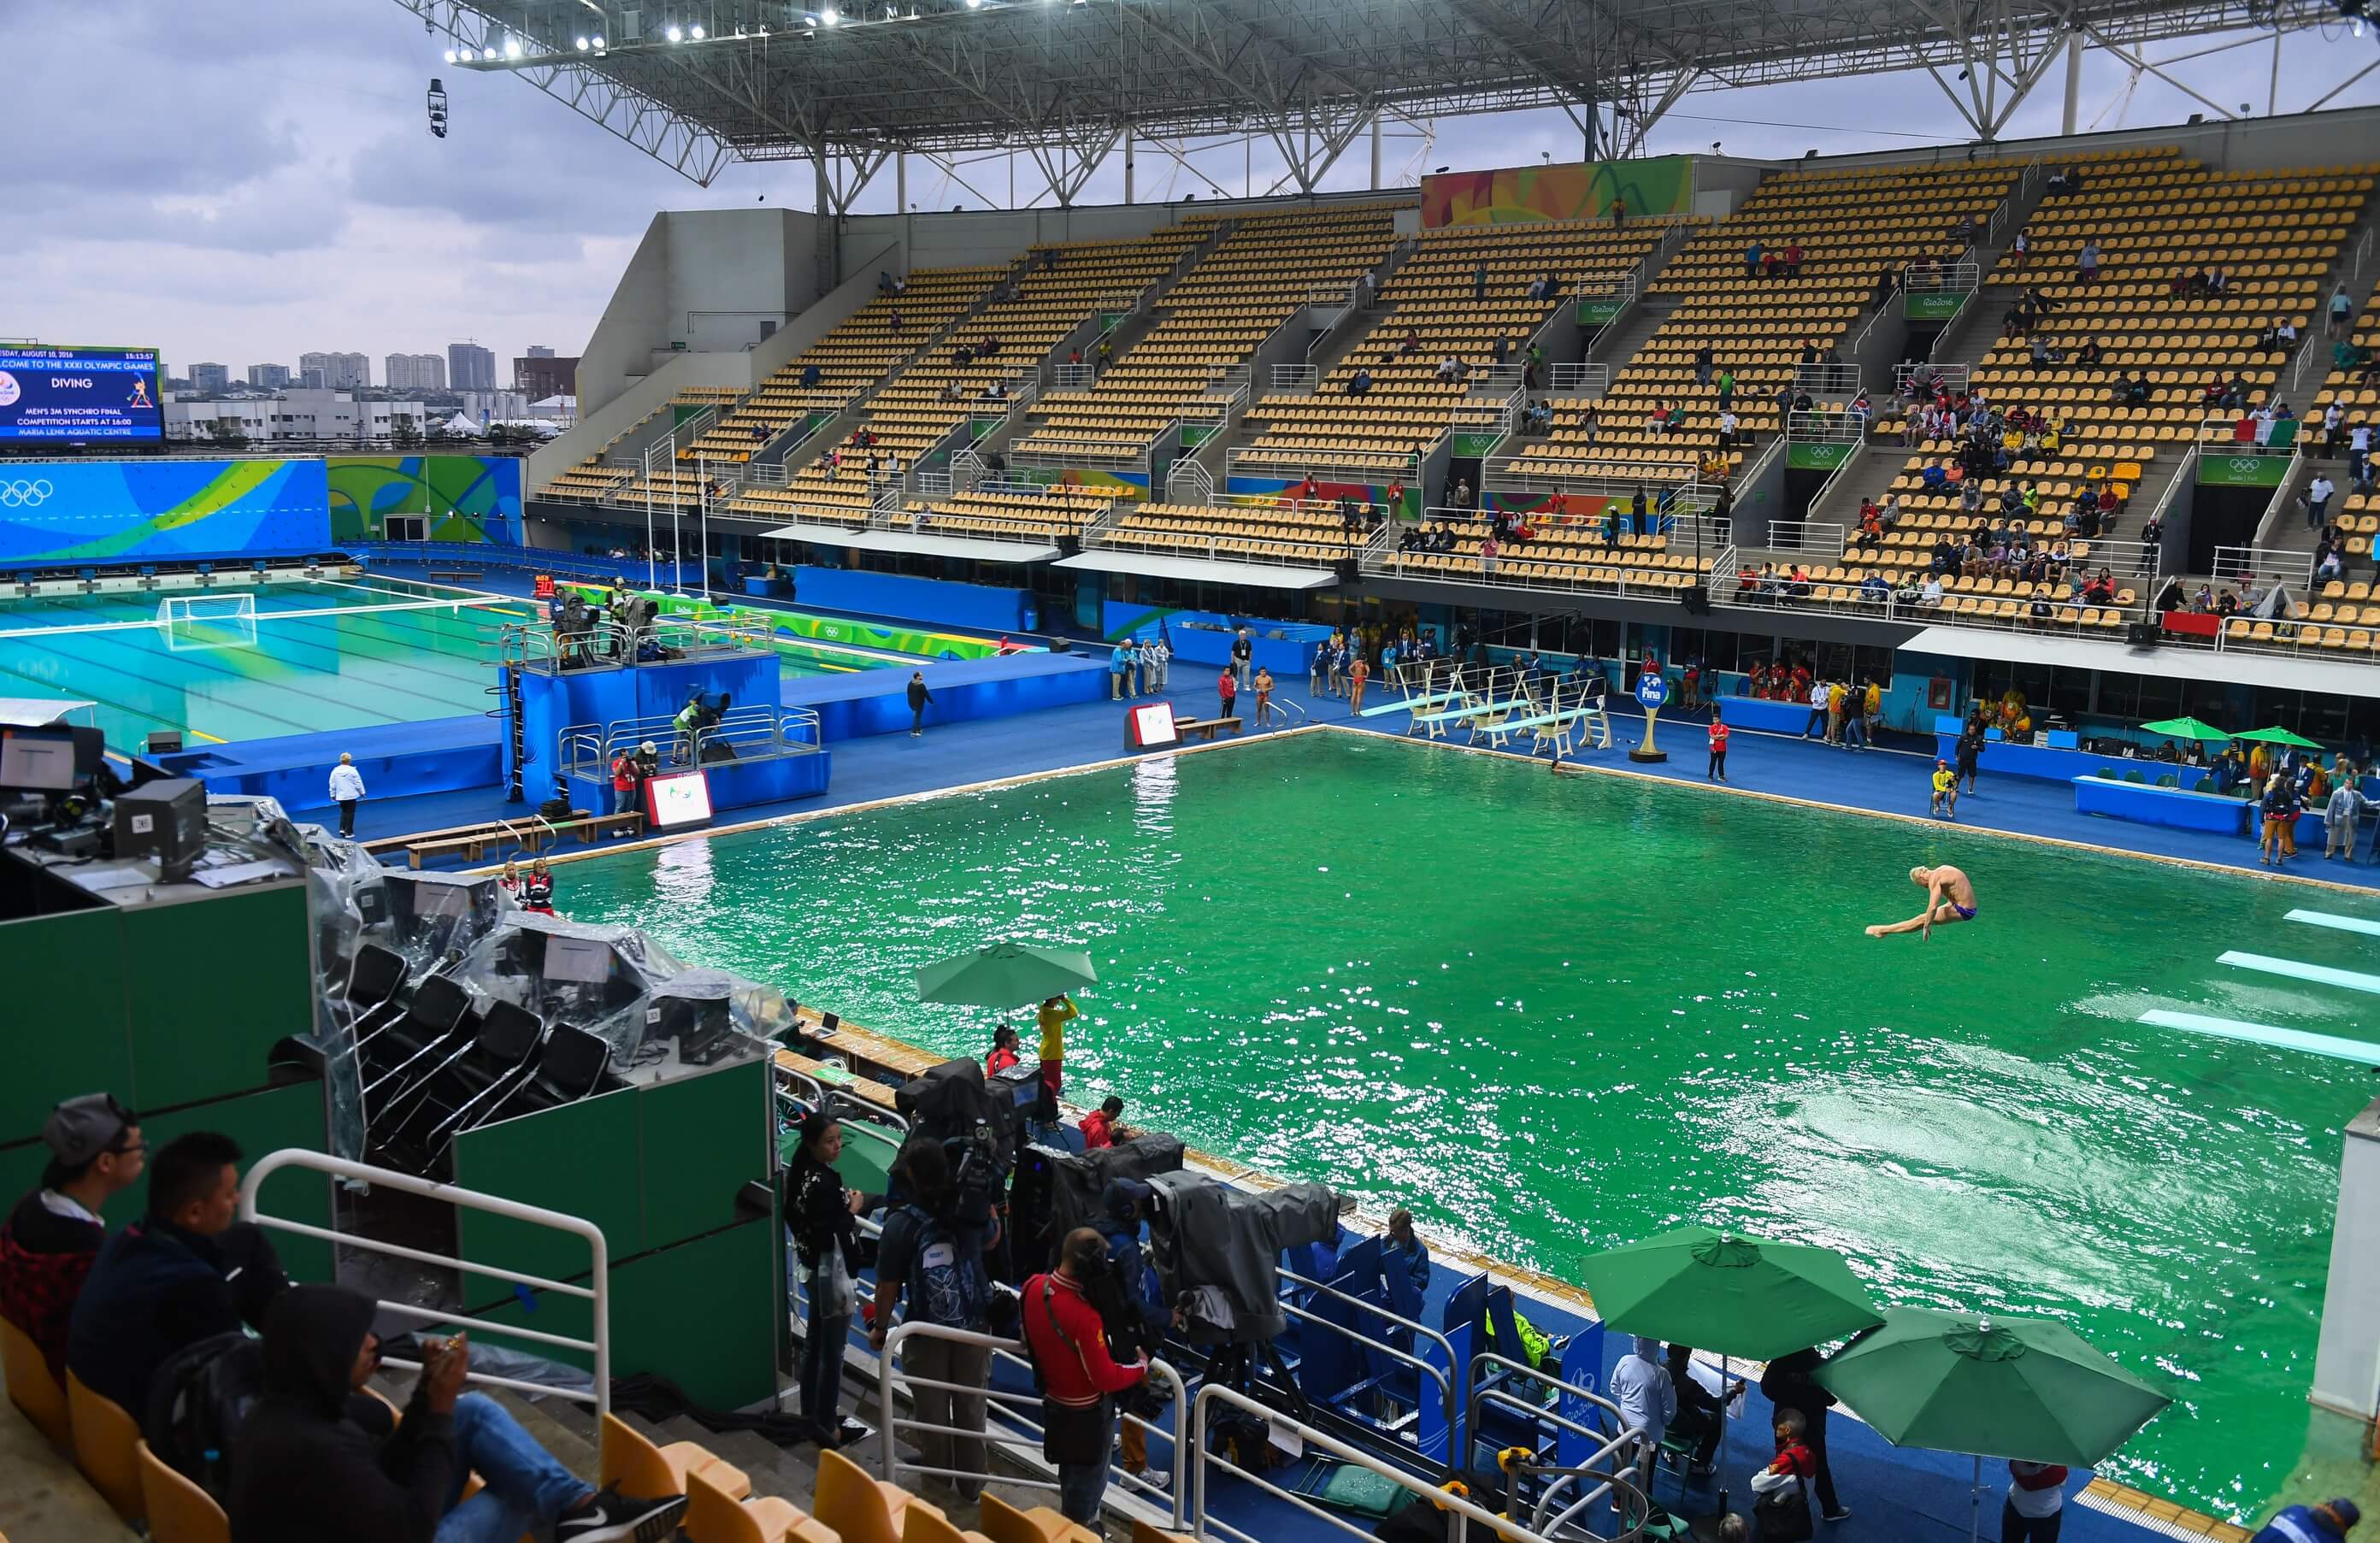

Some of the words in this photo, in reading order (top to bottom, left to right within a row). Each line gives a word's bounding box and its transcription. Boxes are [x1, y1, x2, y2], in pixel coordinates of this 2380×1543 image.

[0, 360, 29, 368] COME
[32, 360, 44, 368] TO
[46, 361, 62, 369] THE
[64, 361, 82, 369] XXXI
[84, 362, 122, 370] OLYMPIC
[123, 362, 154, 370] GAMES
[51, 378, 93, 389] DIVING
[537, 581, 554, 592] 30
